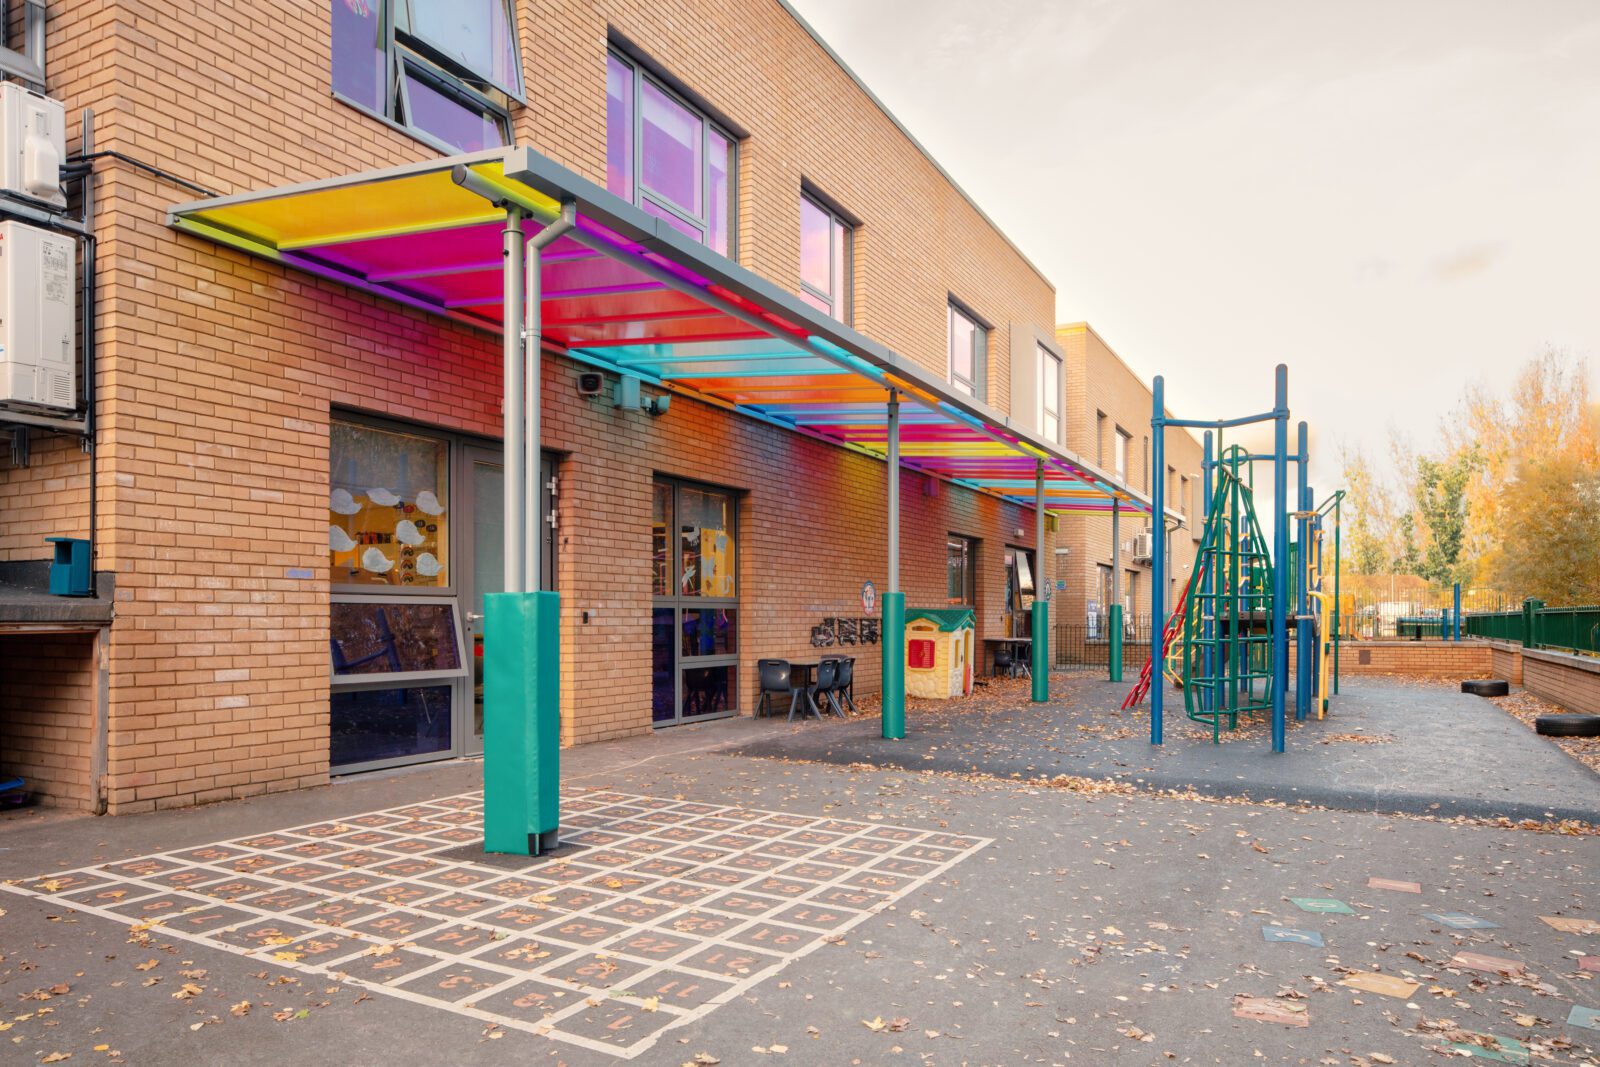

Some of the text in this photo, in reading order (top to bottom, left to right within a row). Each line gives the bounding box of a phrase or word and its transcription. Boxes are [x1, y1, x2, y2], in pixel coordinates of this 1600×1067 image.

[385, 864, 428, 872] 37
[170, 874, 207, 883] 19
[442, 872, 480, 884] 36
[379, 887, 424, 898] 26
[658, 886, 698, 896] 43
[144, 901, 174, 910] 8
[438, 898, 480, 911] 25
[614, 903, 656, 917] 33
[723, 898, 767, 909] 42
[317, 904, 355, 918] 16
[796, 911, 838, 922] 41
[192, 914, 224, 924] 7
[370, 917, 414, 932] 15
[560, 924, 606, 938] 23
[752, 928, 800, 944] 31
[436, 932, 480, 947] 14
[630, 938, 678, 952] 22
[308, 943, 337, 952] 5
[372, 956, 401, 969] 4
[705, 952, 753, 970] 21
[438, 976, 472, 989] 3
[656, 980, 698, 998] 11
[608, 1015, 632, 1031] 1
